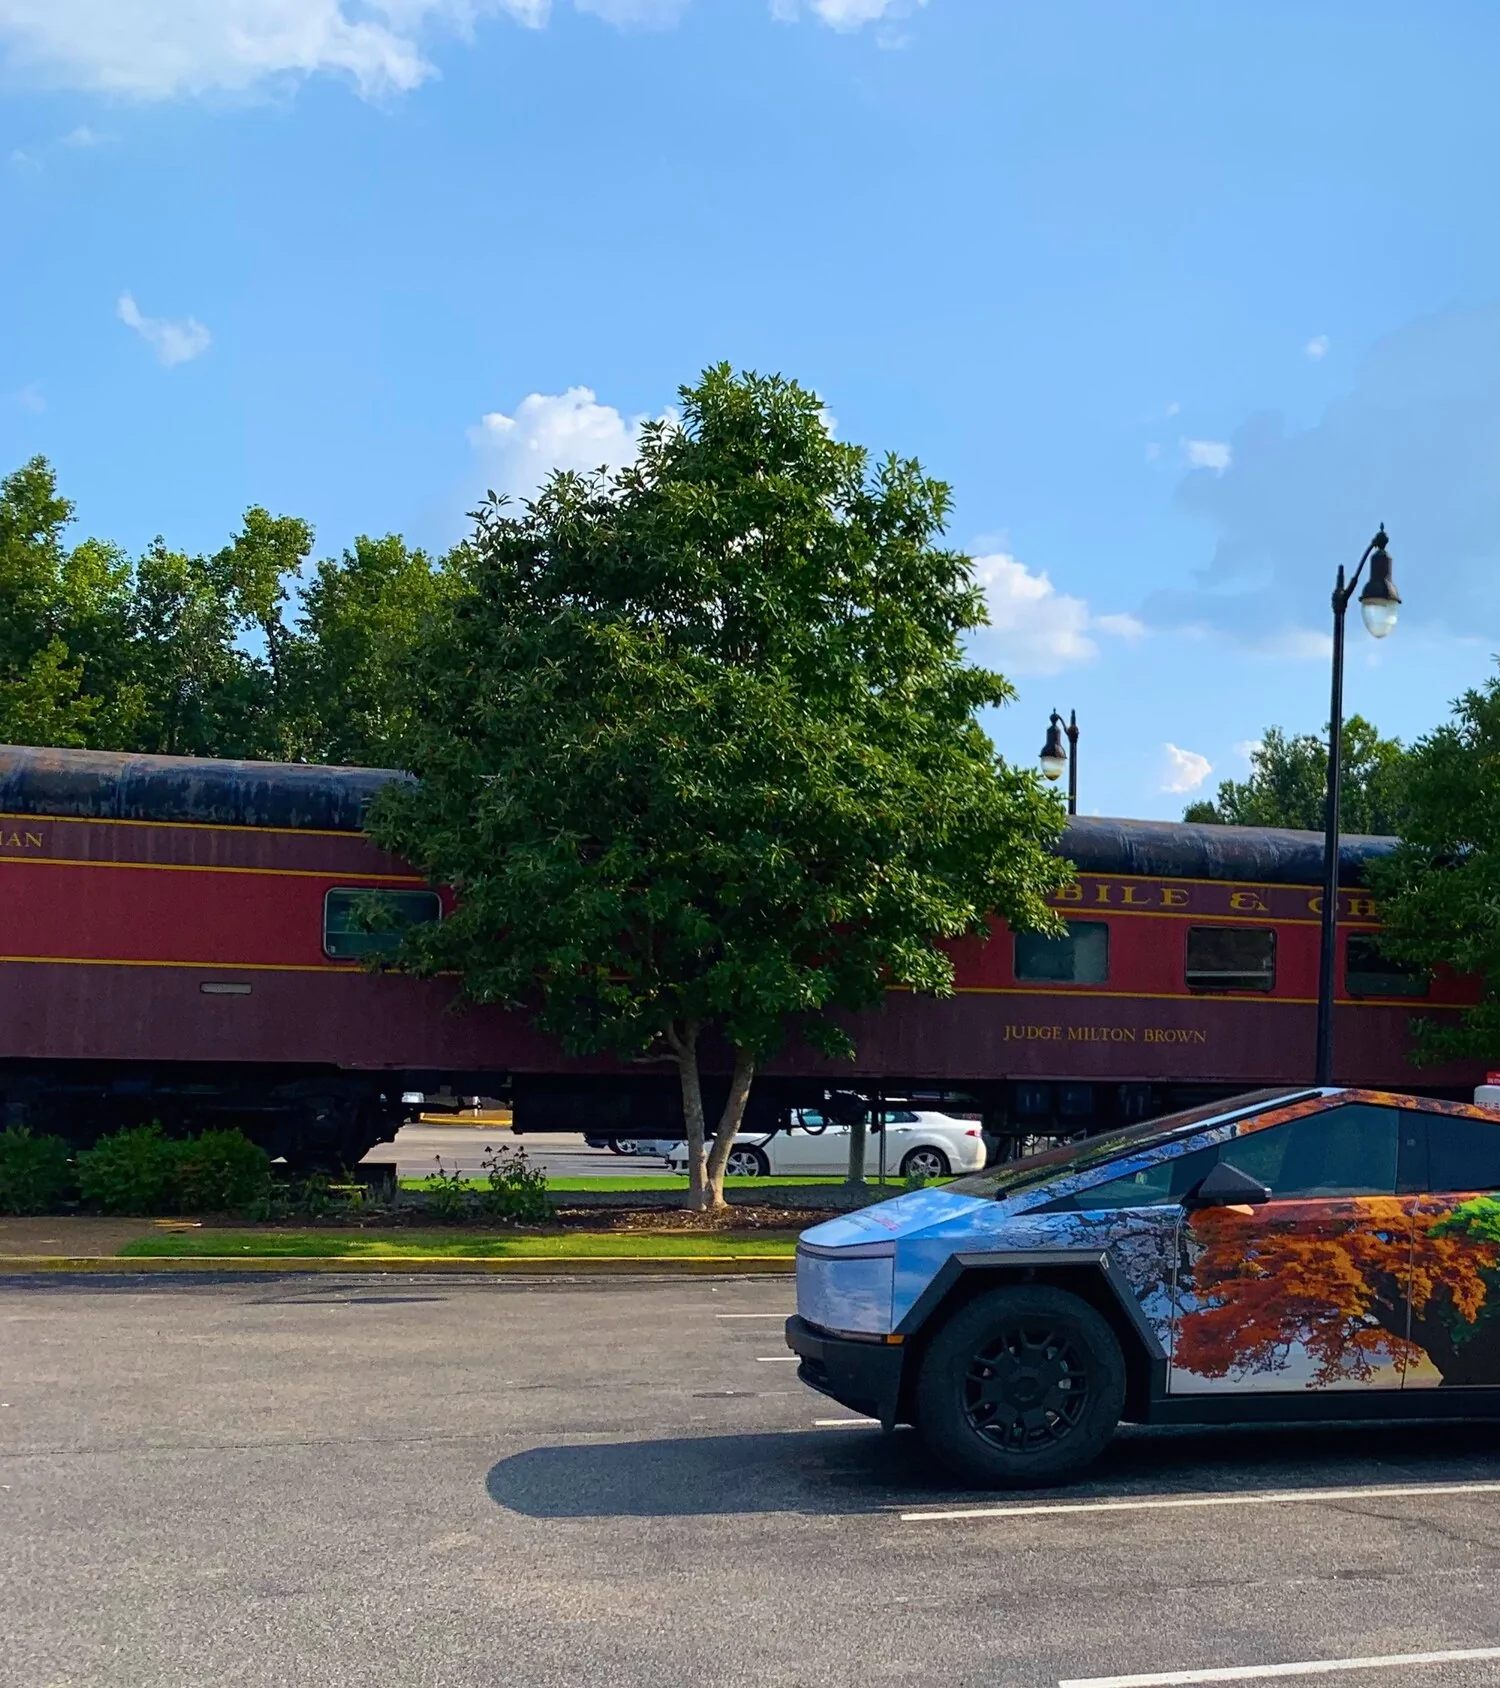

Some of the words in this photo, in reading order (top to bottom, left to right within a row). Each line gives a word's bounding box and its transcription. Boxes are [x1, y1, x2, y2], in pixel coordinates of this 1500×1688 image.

[1229, 892, 1270, 912] &
[1003, 1025, 1062, 1041] JUDGE
[1067, 1026, 1136, 1042] MILTON
[1143, 1028, 1207, 1044] BROWN
